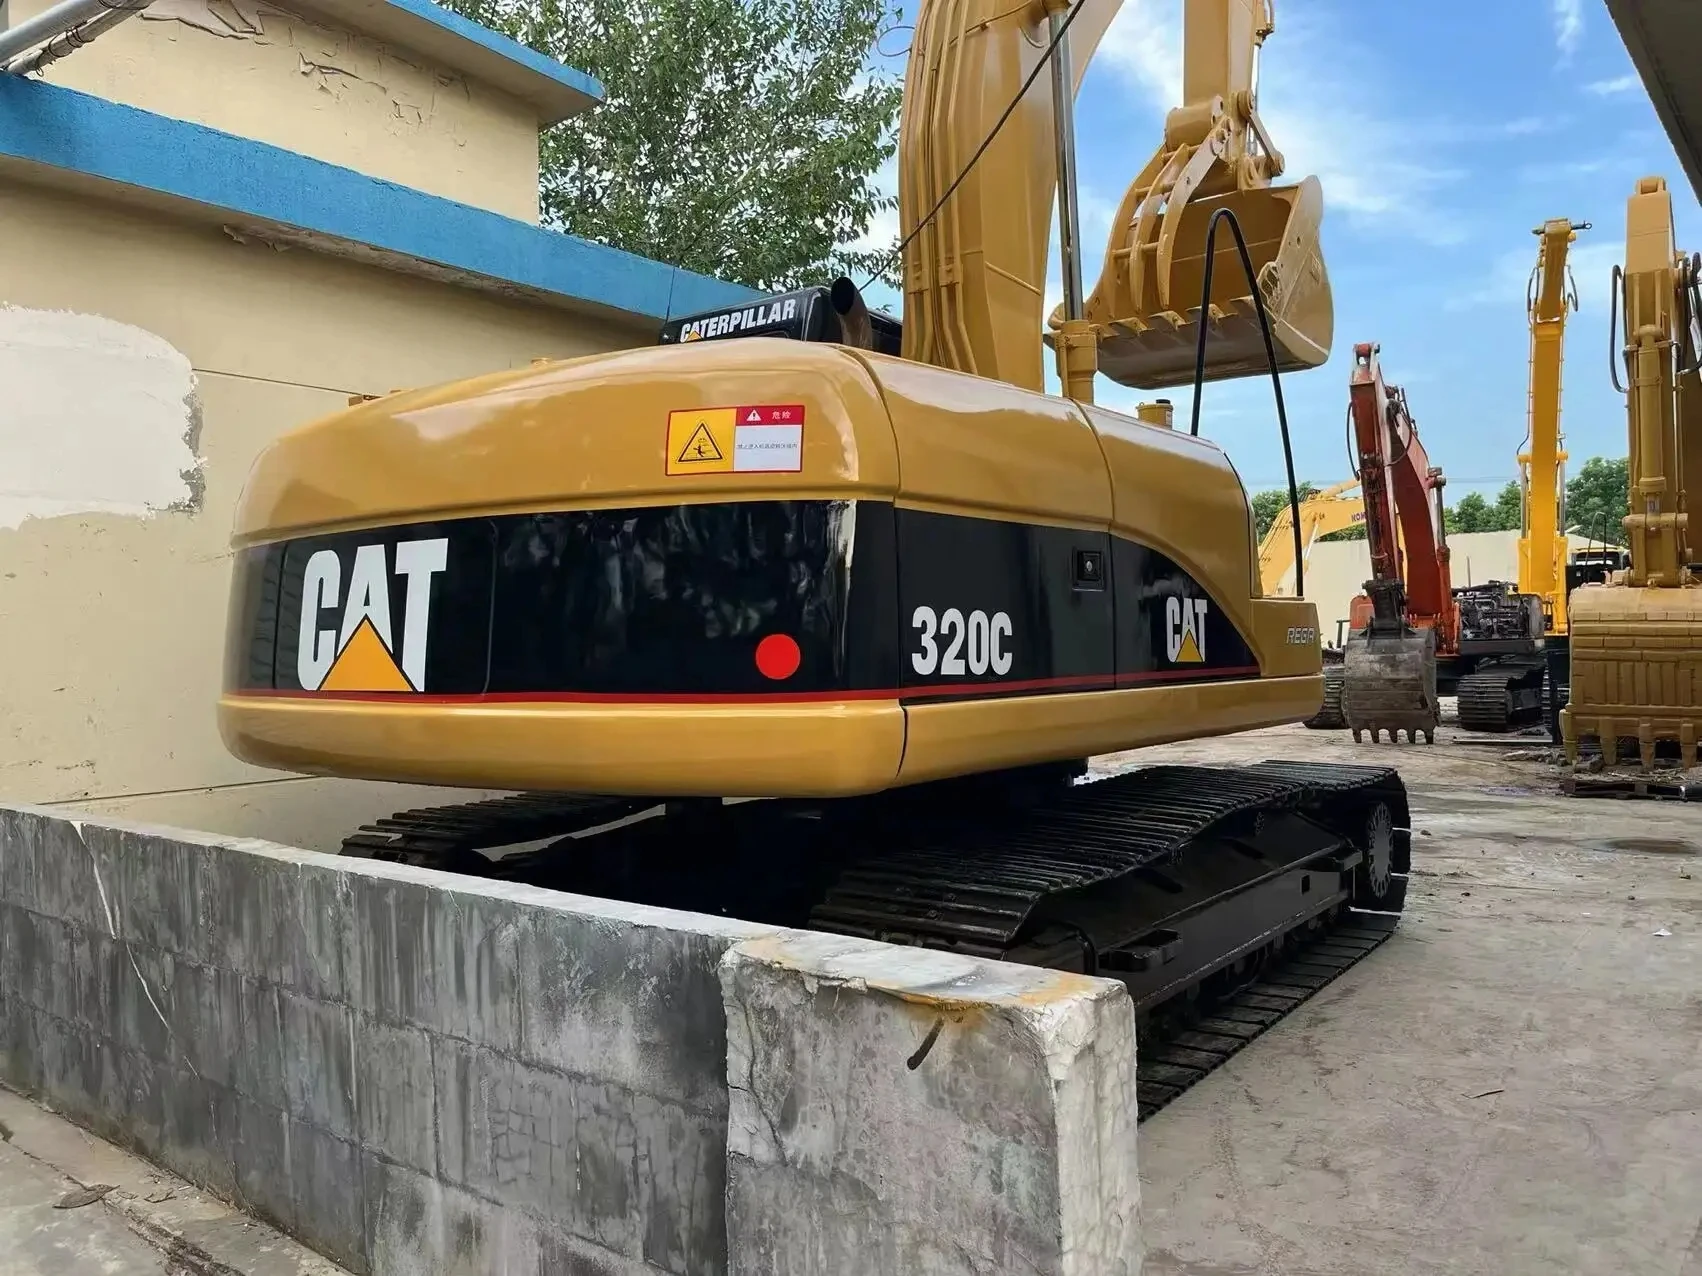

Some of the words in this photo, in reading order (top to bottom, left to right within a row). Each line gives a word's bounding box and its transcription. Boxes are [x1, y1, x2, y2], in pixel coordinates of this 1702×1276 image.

[680, 299, 796, 343] CATERPILLAR
[298, 538, 449, 692] CAT
[911, 606, 1013, 676] 320C
[1166, 597, 1207, 662] CAT
